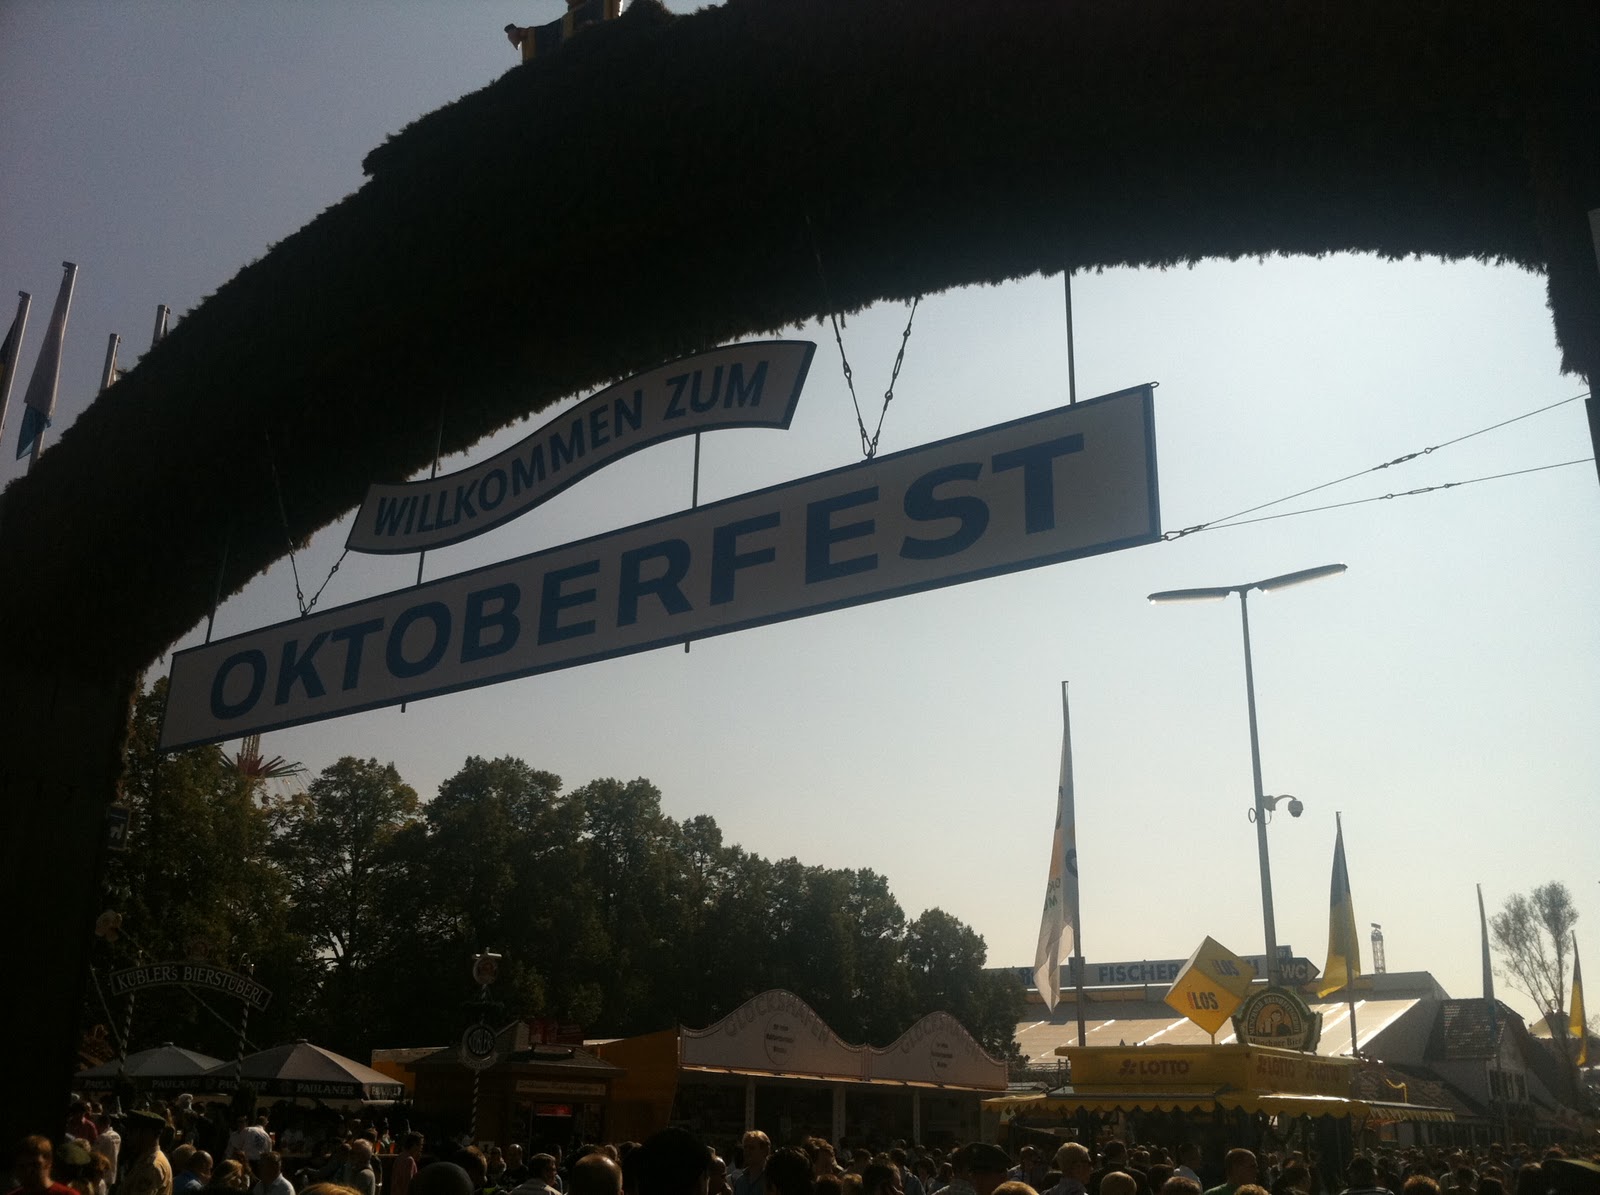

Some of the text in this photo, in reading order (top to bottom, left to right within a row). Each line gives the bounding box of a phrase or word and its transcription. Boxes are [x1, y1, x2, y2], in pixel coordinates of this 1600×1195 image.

[373, 360, 770, 537] WILLKOMMEN ZUM
[209, 433, 1084, 721] OKTOBERFEST
[1100, 963, 1179, 983] FISCHER
[1216, 959, 1240, 977] LOS
[1281, 964, 1308, 979] WC
[1191, 991, 1219, 1010] LOS
[1249, 1037, 1286, 1047] Mnchner
[1140, 1059, 1190, 1075] LOTTO
[296, 1082, 354, 1095] PAULANER
